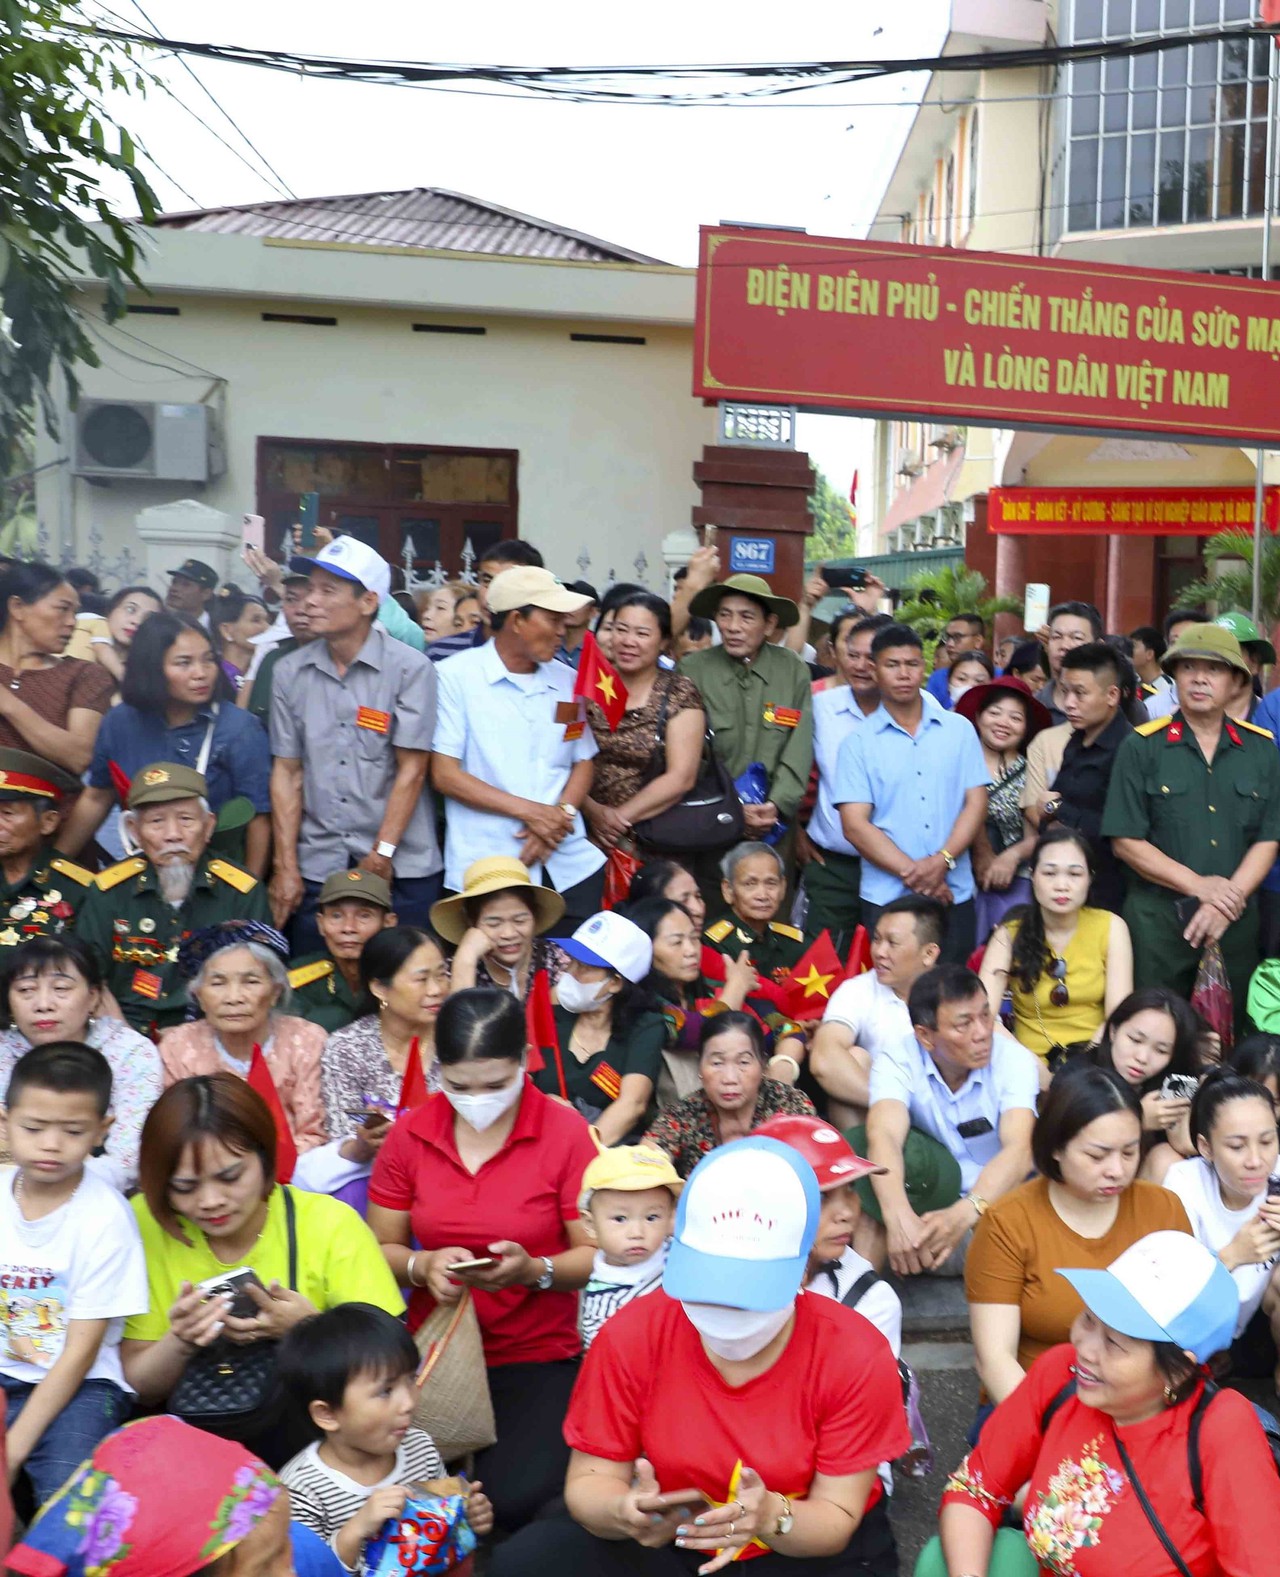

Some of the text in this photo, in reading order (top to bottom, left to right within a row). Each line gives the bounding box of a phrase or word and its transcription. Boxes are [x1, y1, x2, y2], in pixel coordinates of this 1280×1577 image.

[747, 263, 811, 316] ĐIỆN
[817, 269, 880, 316] BIÊN
[886, 272, 940, 321] PHỦ
[964, 281, 1041, 330] CHIẾN
[1048, 286, 1129, 339] THẮNG
[1136, 295, 1185, 344] CỦA
[1191, 305, 1241, 350] SỨC
[943, 342, 1229, 410] VÀ LÒNG DÂN VIỆT NAM
